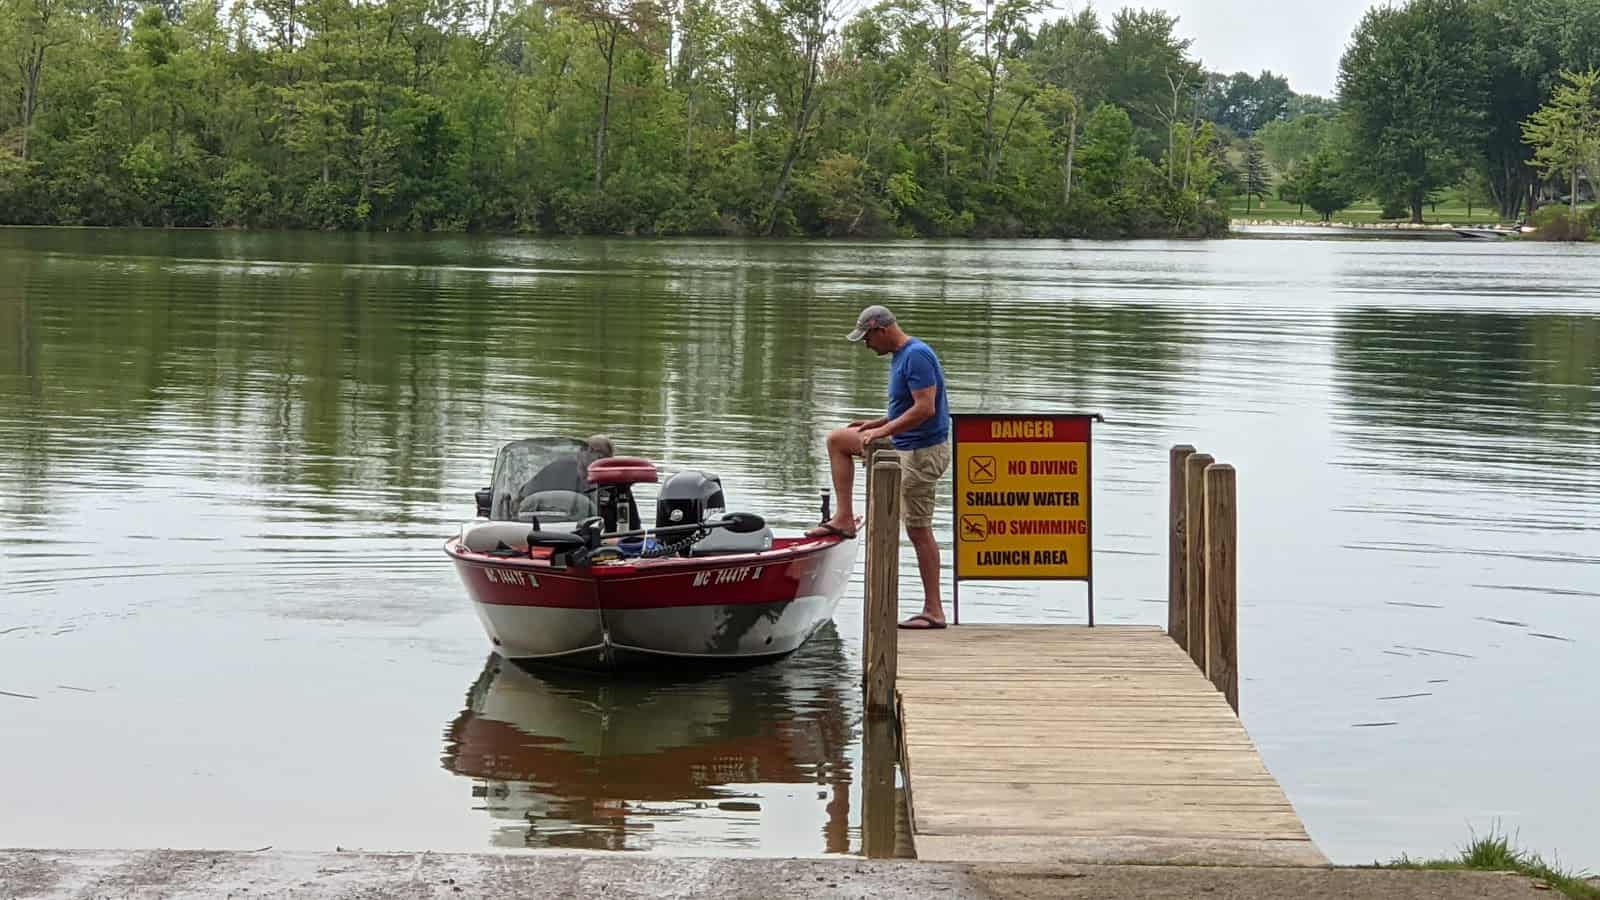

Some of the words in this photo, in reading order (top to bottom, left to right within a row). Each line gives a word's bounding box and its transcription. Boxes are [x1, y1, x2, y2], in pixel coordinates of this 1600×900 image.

[991, 421, 1054, 438] DANGER
[1008, 461, 1026, 475] NO
[1030, 460, 1078, 475] DIVING
[966, 491, 1030, 506] SHALLOW
[1033, 491, 1079, 506] WATER
[988, 521, 1006, 535] NO
[1010, 520, 1087, 535] SWIMMING
[977, 551, 1030, 565] LAUNCH
[1034, 550, 1068, 565] AREA
[693, 570, 711, 587] MC
